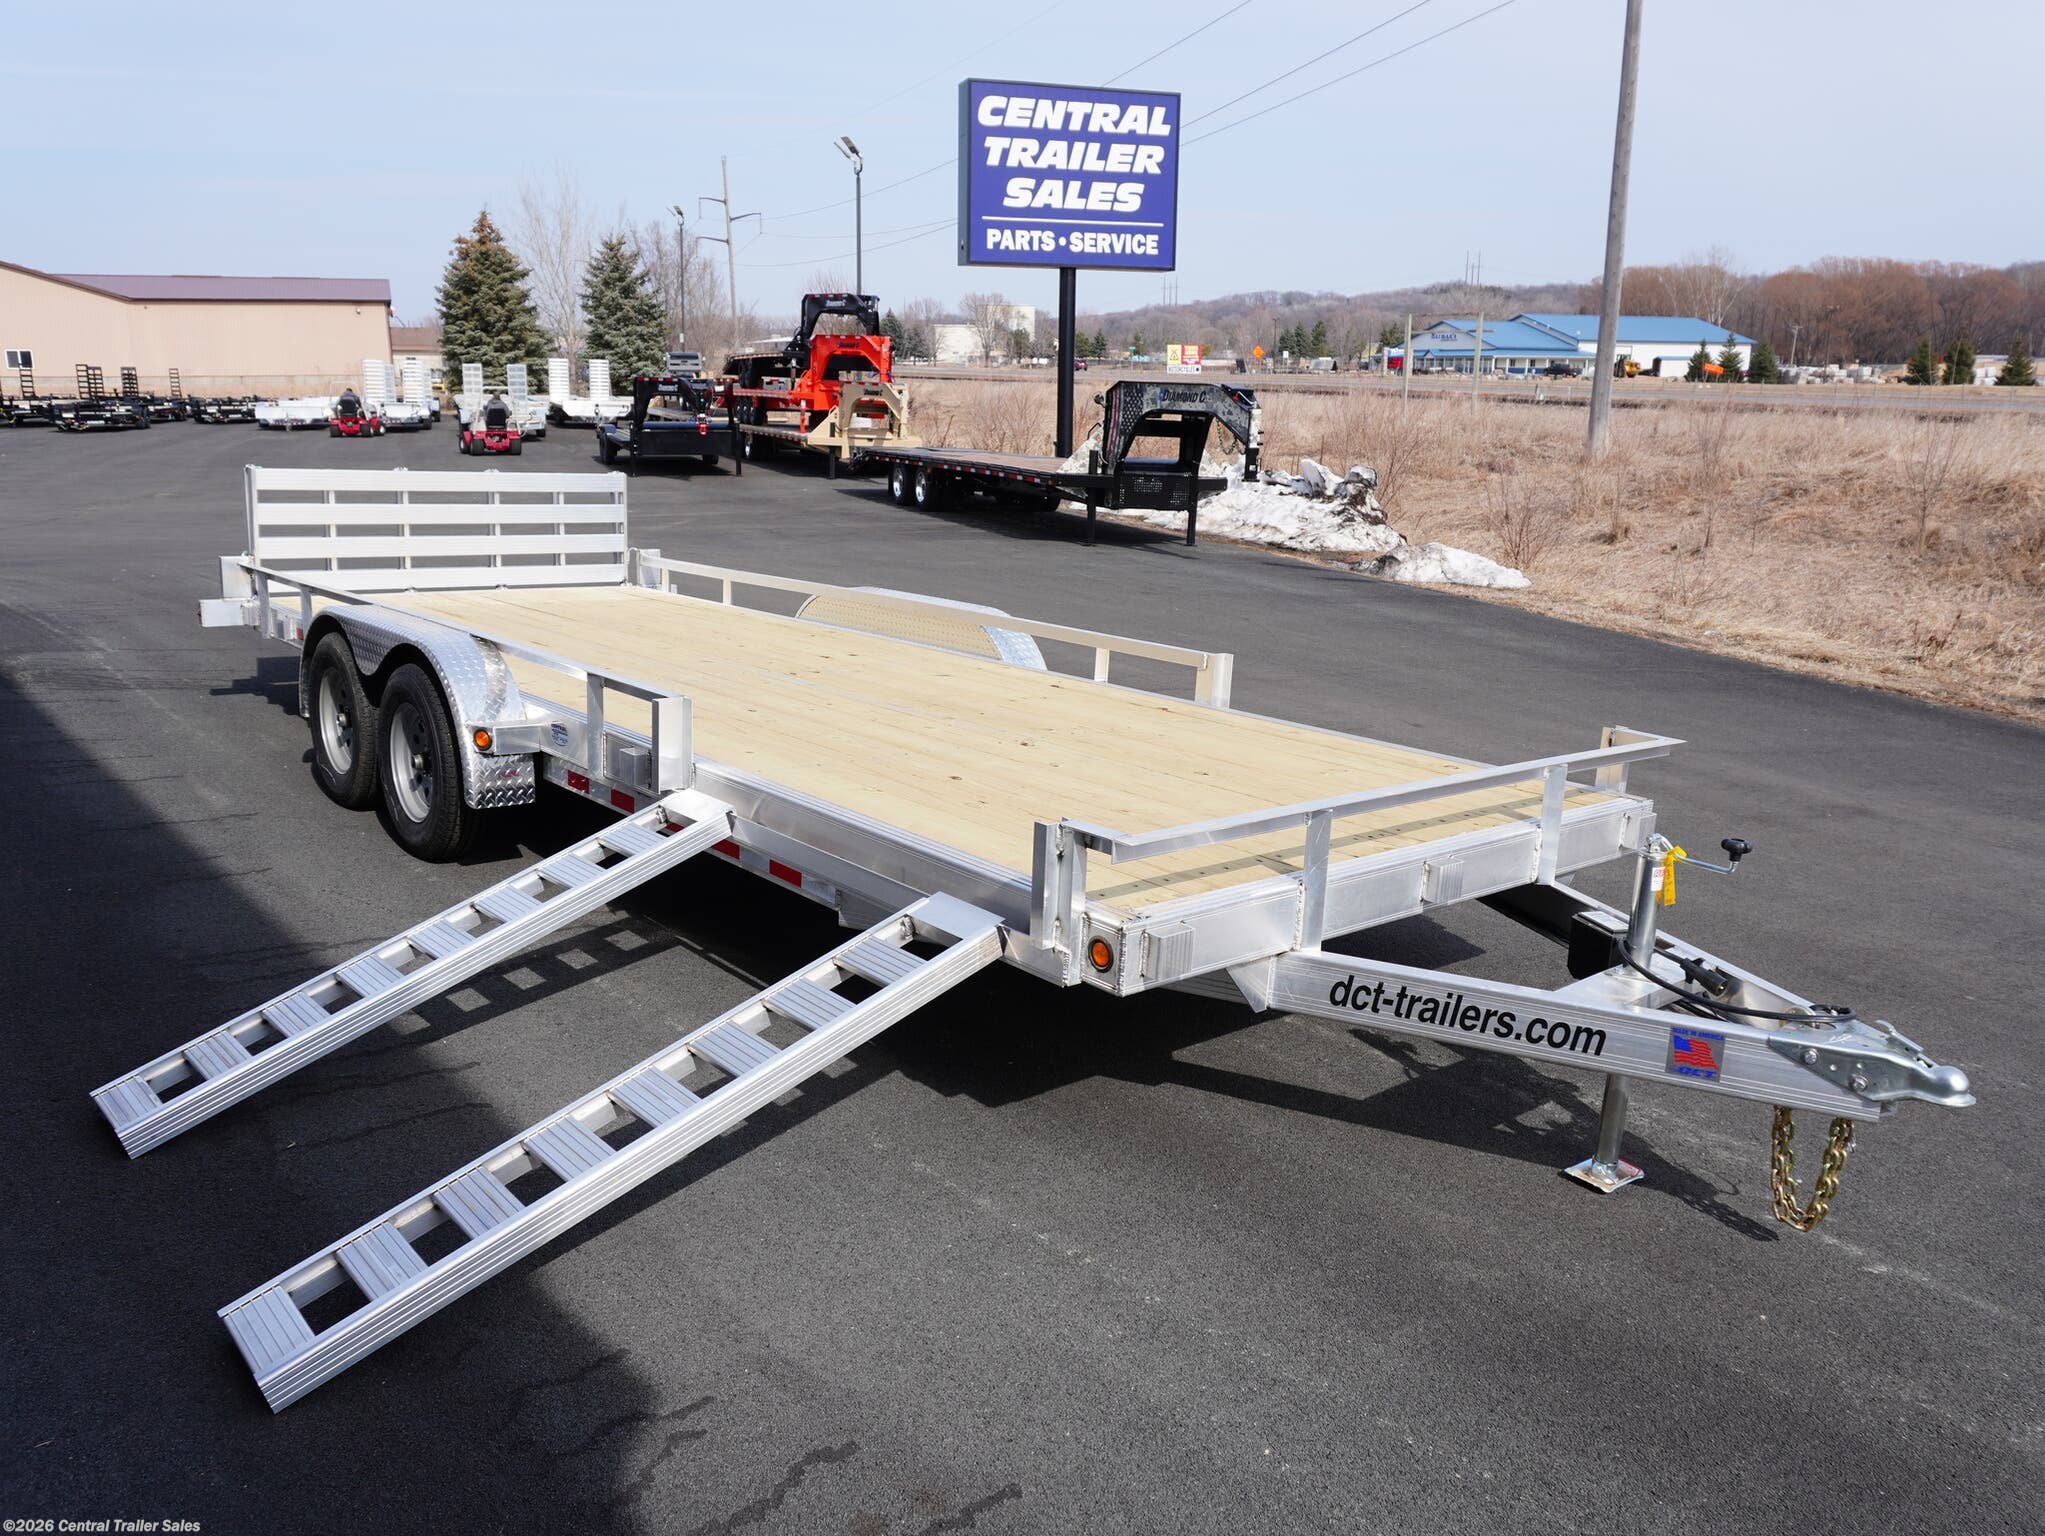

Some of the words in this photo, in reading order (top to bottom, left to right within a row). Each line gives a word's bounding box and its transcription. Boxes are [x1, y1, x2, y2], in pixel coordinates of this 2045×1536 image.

[977, 95, 1171, 136] CENTRAL
[984, 136, 1165, 175] TRAILER
[1002, 177, 1145, 212] SALES
[986, 228, 1056, 252] PARTS
[1069, 231, 1159, 255] SERVICE
[1329, 975, 1607, 1056] dct-trailers.com
